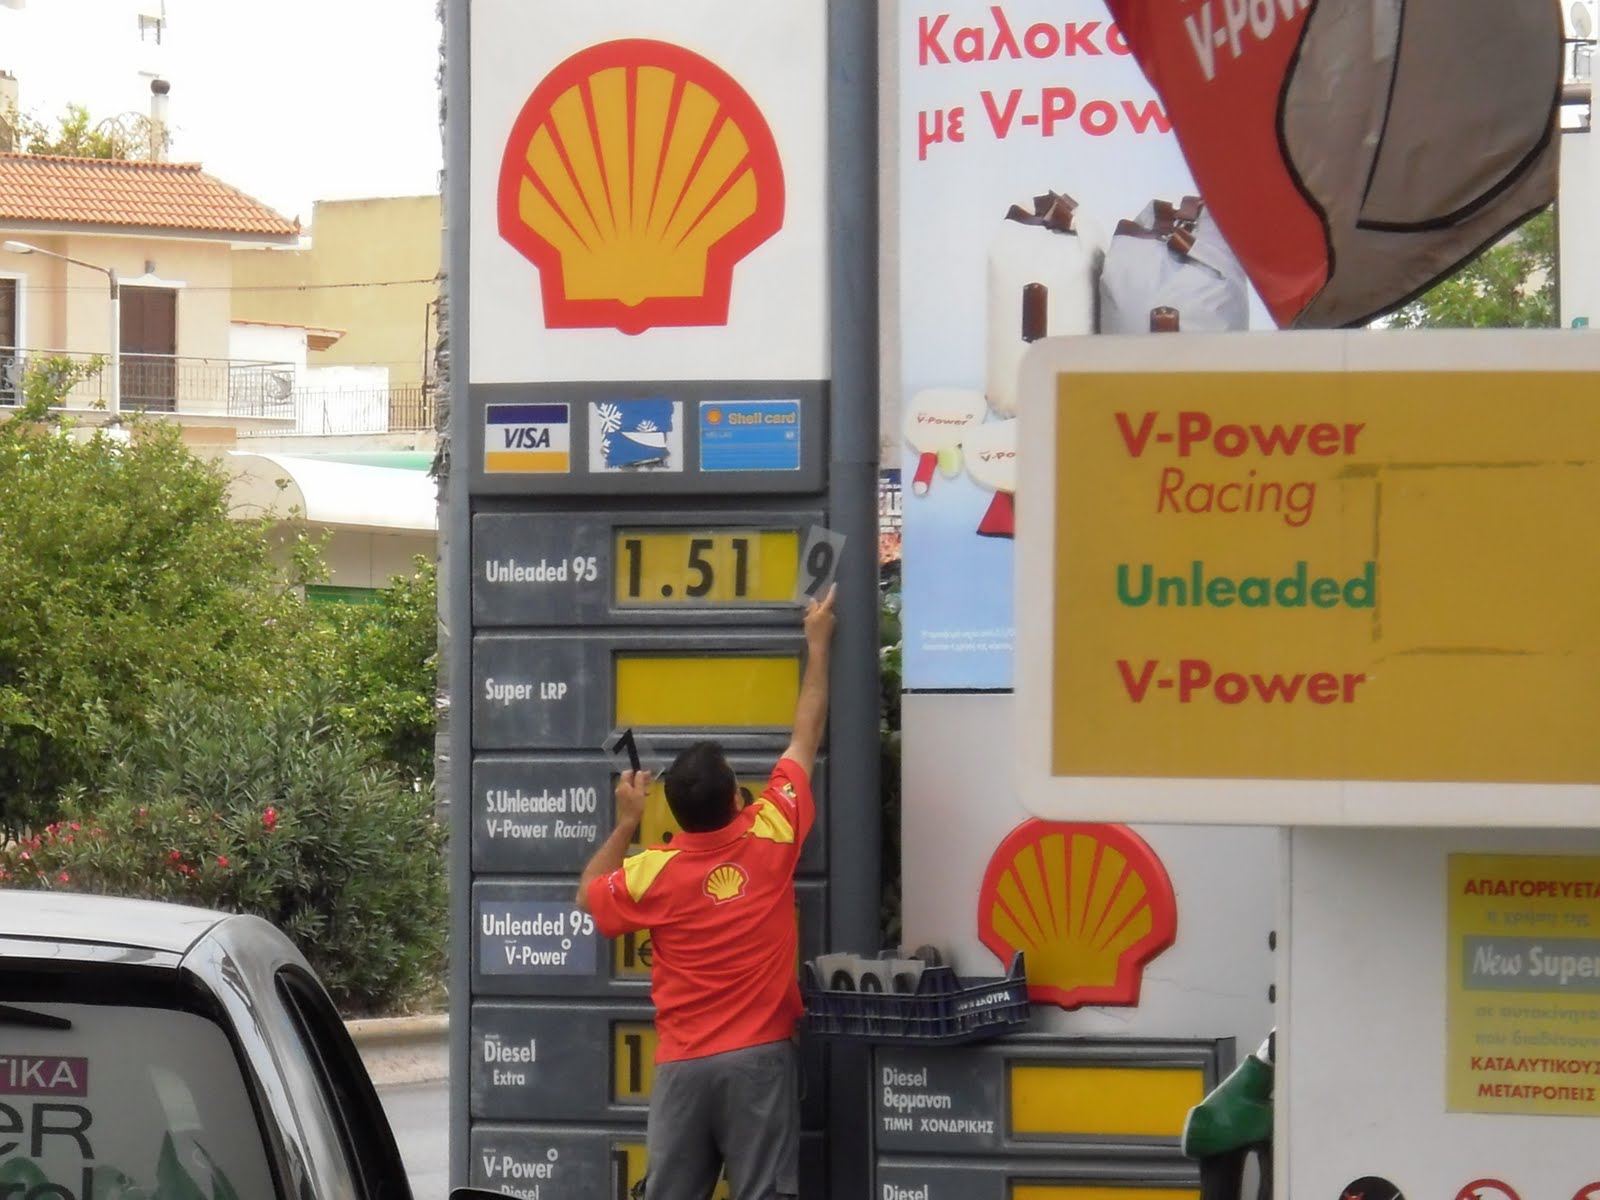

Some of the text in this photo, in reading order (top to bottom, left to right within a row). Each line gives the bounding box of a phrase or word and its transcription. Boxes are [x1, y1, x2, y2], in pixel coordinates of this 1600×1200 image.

[918, 107, 965, 160] με
[728, 411, 796, 425] Shell card
[917, 416, 968, 426] V-Power
[504, 427, 551, 449] VISA
[1114, 411, 1366, 458] V-Power
[1156, 467, 1317, 527] Racing
[486, 556, 597, 582] Unleaded 95
[804, 541, 834, 596] 9
[1116, 560, 1376, 608] Unleaded
[485, 678, 567, 705] Super LRP
[1116, 659, 1367, 704] V-Power
[486, 787, 597, 813] S.Unleaded 100
[486, 819, 597, 842] V-Power Racing
[482, 910, 594, 936] Unleaded 95
[505, 945, 567, 965] V-Power
[1472, 943, 1522, 976] New
[484, 1039, 536, 1063] Diesel
[624, 1034, 641, 1093] 1
[493, 1069, 526, 1086] Extra
[883, 1067, 927, 1087] Diesel
[1478, 1083, 1596, 1102] ΜΕΤΑΤΡΟΠΕΙΣ
[883, 1118, 994, 1134] ΤΙΜΗ ΧΟΝΔΡΙΚΗΣ
[483, 1155, 554, 1179] V-Power
